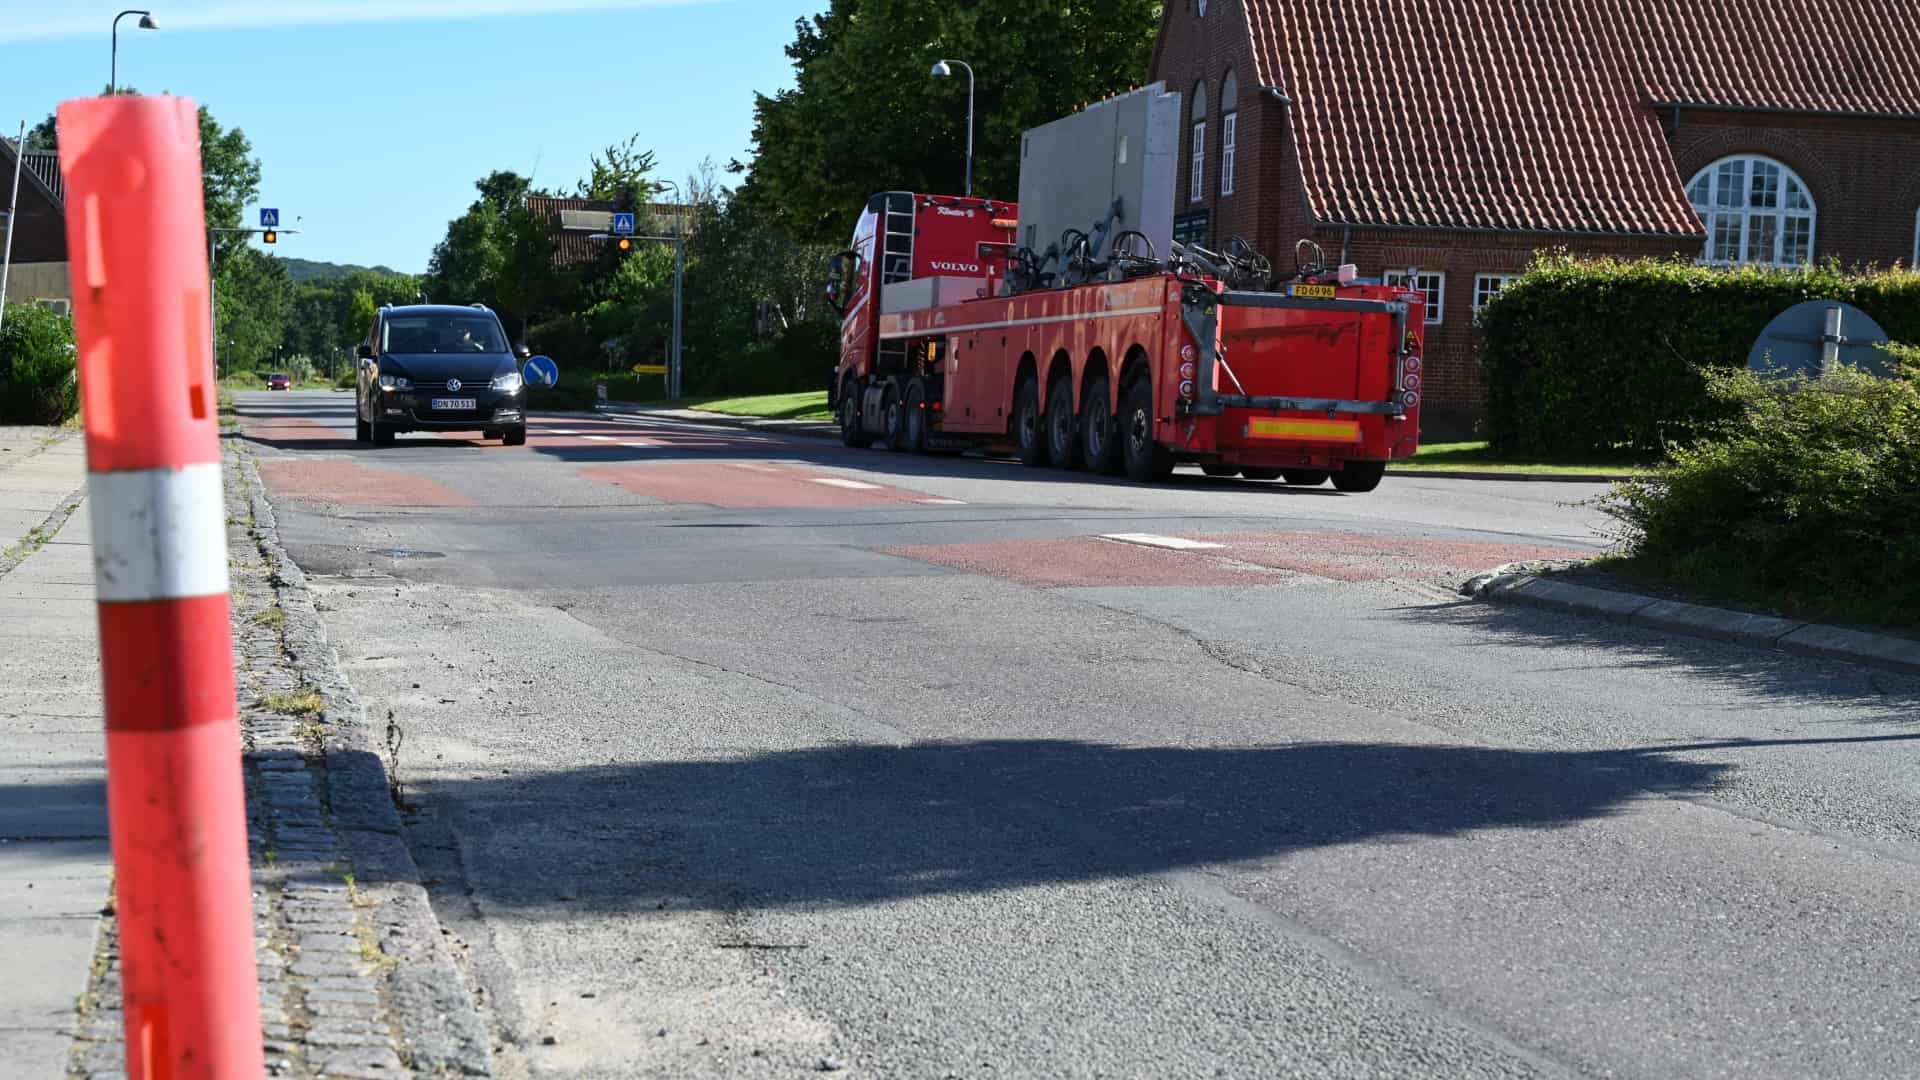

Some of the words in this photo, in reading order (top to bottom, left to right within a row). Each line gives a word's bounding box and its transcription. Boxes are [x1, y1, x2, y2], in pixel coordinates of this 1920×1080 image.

[931, 261, 978, 272] VOLVO
[1295, 286, 1307, 295] FD
[1309, 286, 1320, 296] 69
